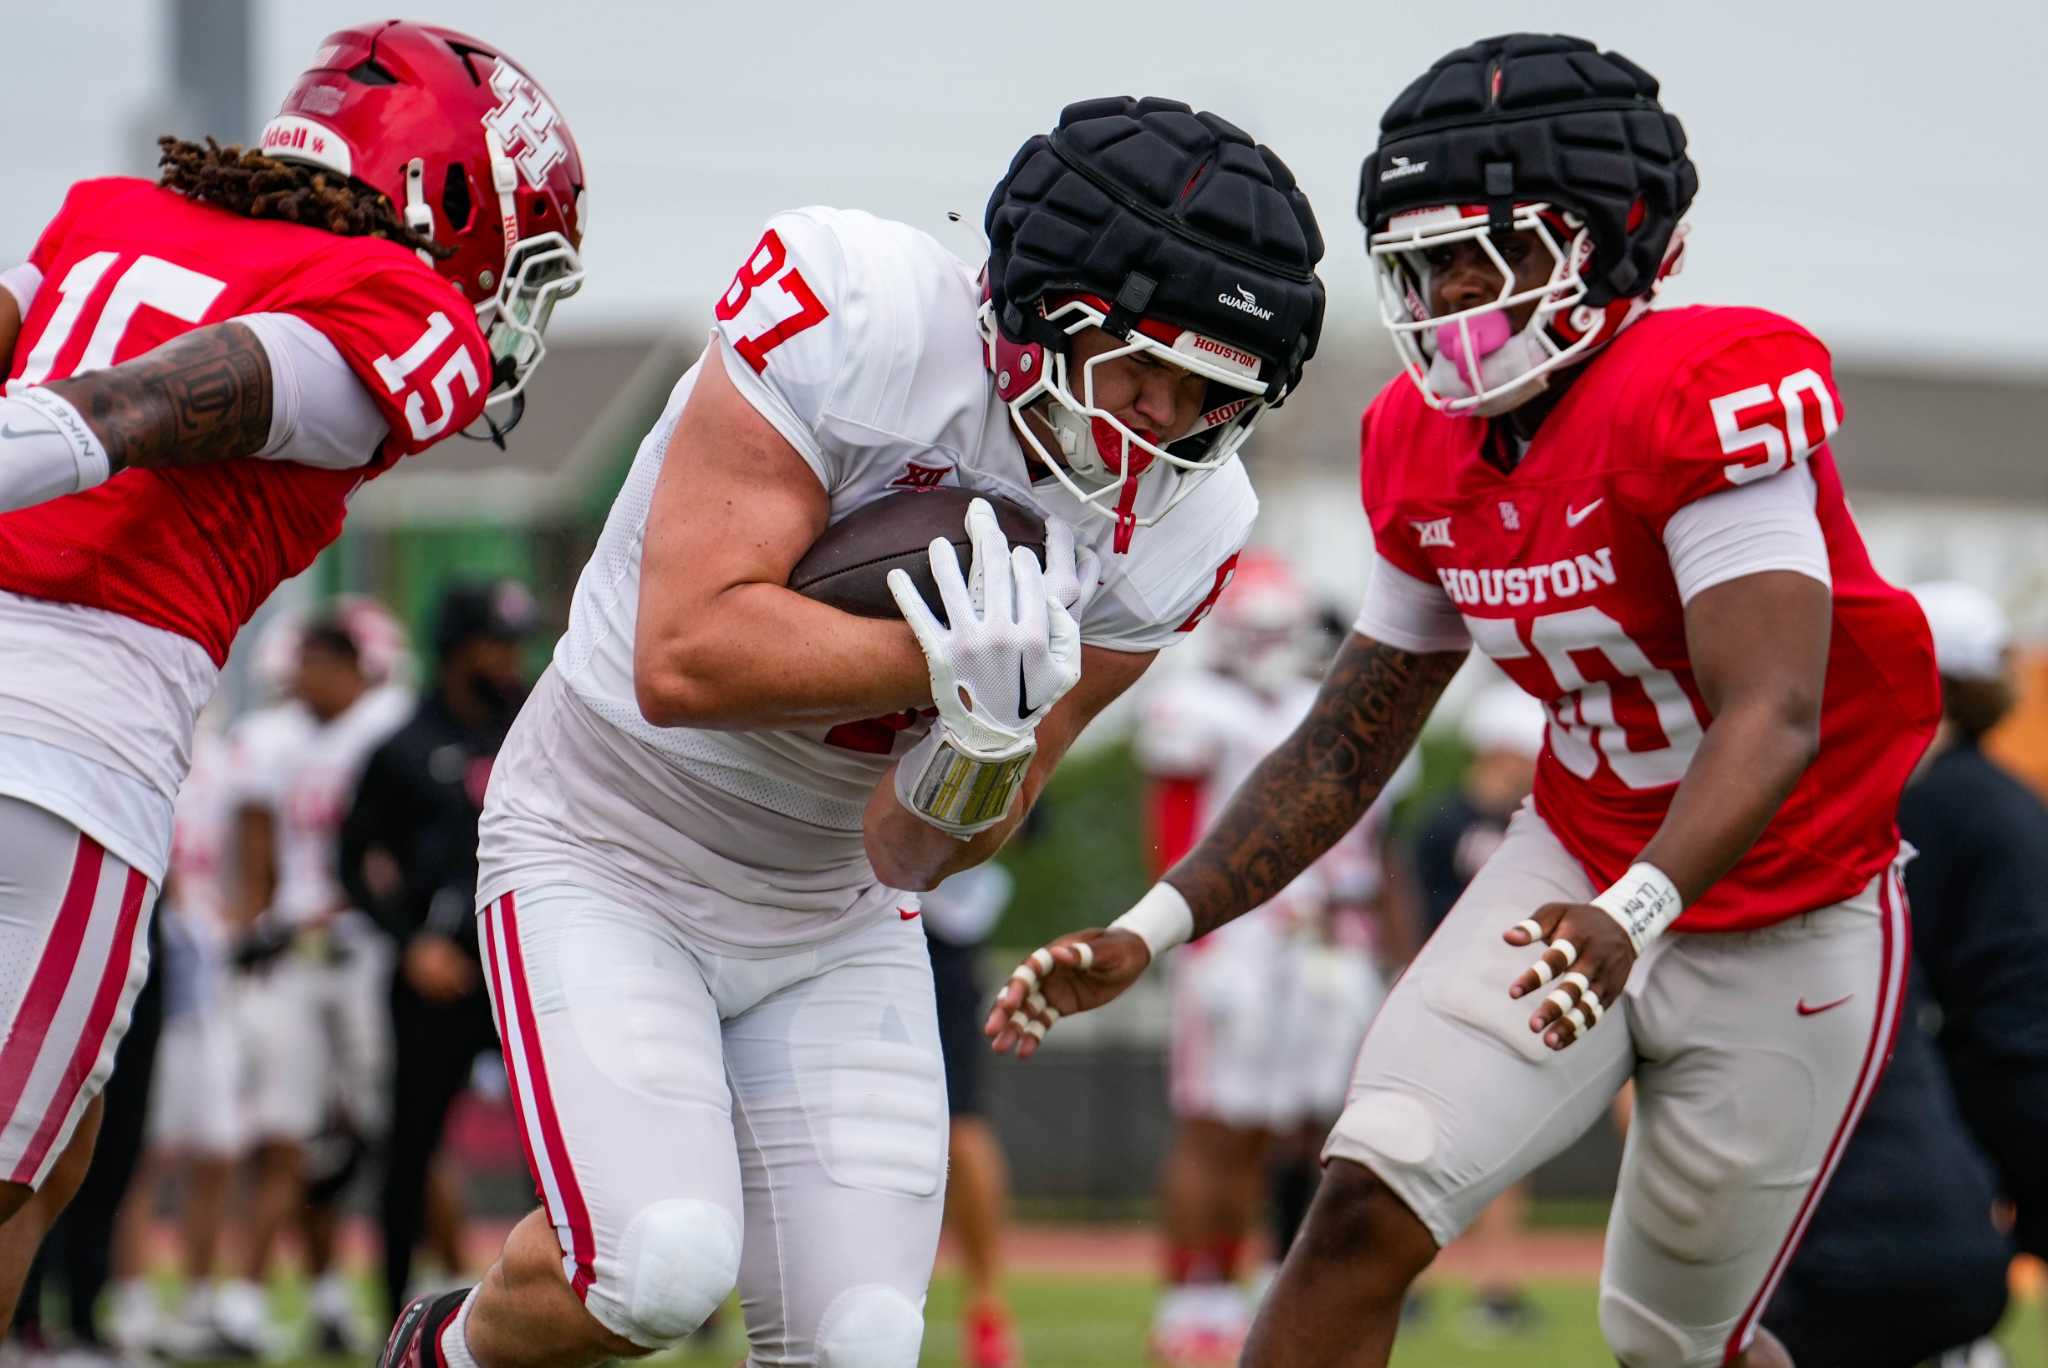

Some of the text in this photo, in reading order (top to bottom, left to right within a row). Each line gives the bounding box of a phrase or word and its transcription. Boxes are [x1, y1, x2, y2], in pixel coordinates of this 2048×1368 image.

[714, 228, 830, 376] 87
[1218, 292, 1274, 321] GUARDIAN
[372, 311, 480, 441] 15
[1194, 334, 1257, 369] HOUSTON
[56, 403, 95, 458] NIKE
[1709, 368, 1840, 486] 50
[1436, 546, 1617, 606] HOUSTON
[1461, 605, 1704, 791] 50
